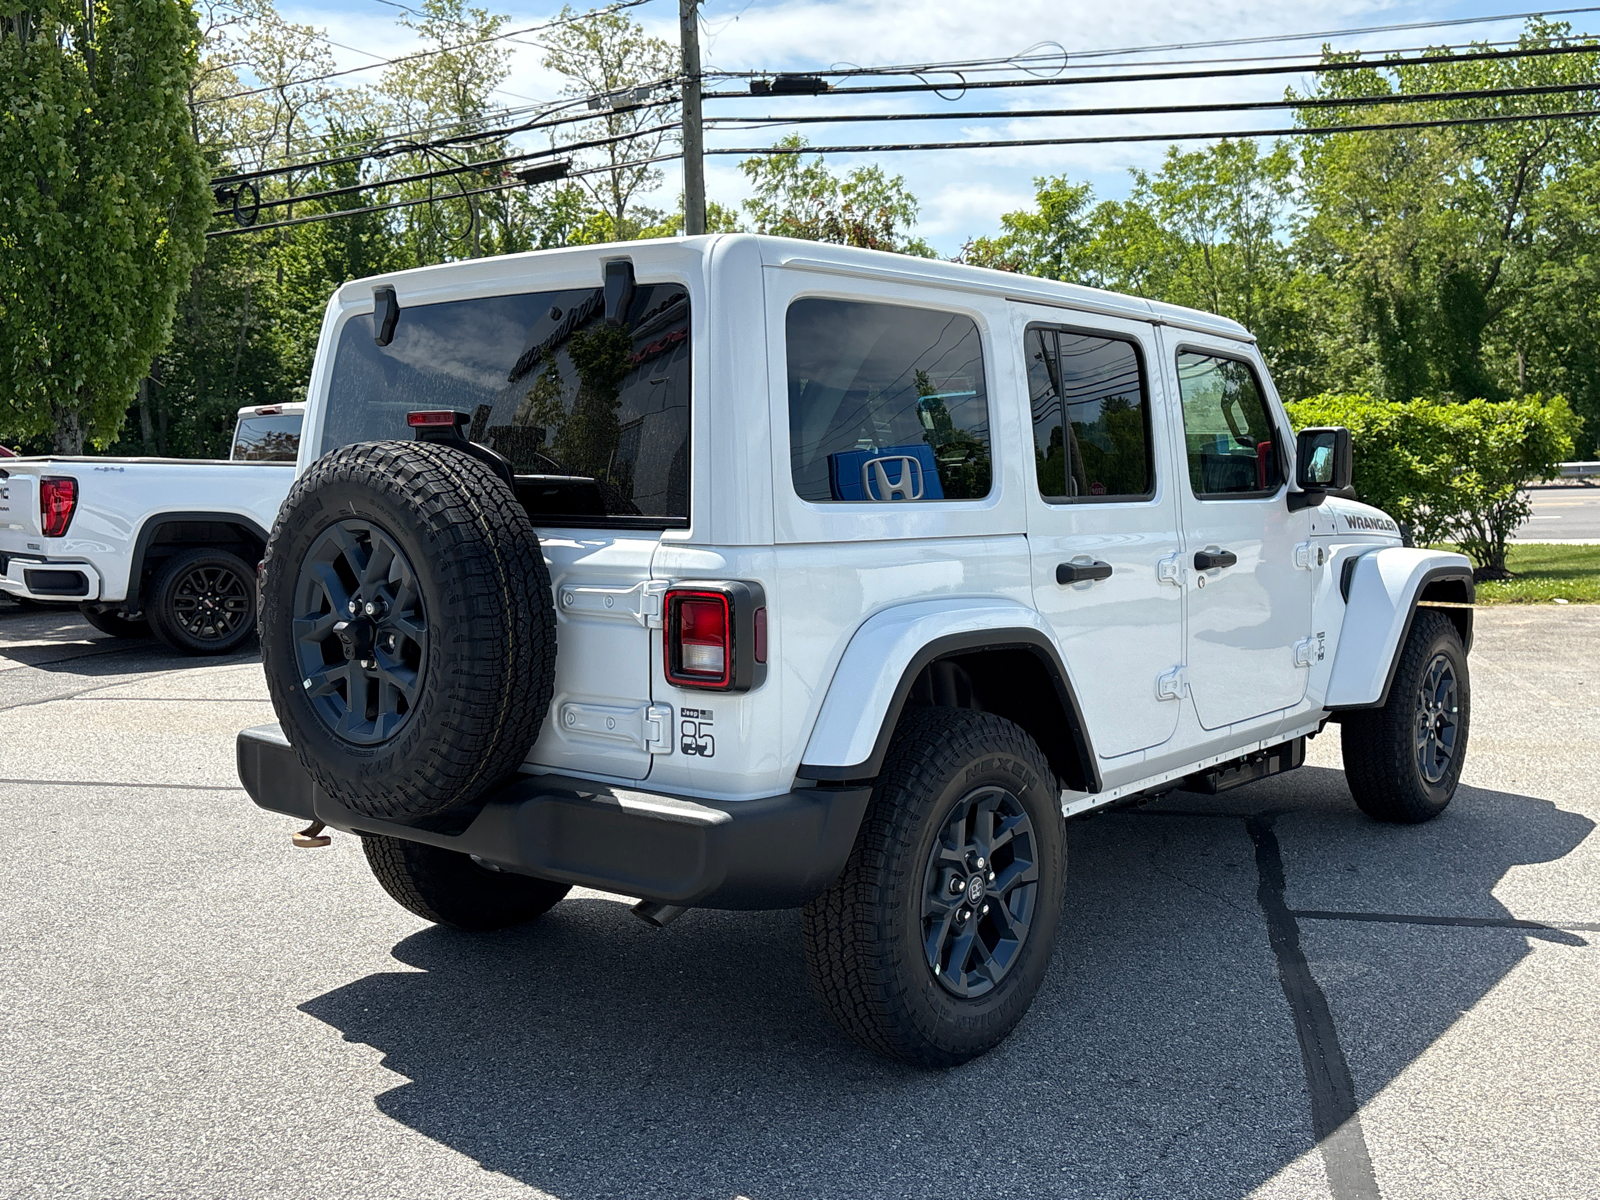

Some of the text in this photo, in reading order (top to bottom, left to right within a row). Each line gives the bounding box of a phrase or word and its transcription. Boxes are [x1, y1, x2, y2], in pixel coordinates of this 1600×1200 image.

[1343, 514, 1397, 532] WRANGLER
[681, 708, 699, 718] Jeep
[681, 720, 715, 757] 85
[965, 757, 1038, 791] NEXEN
